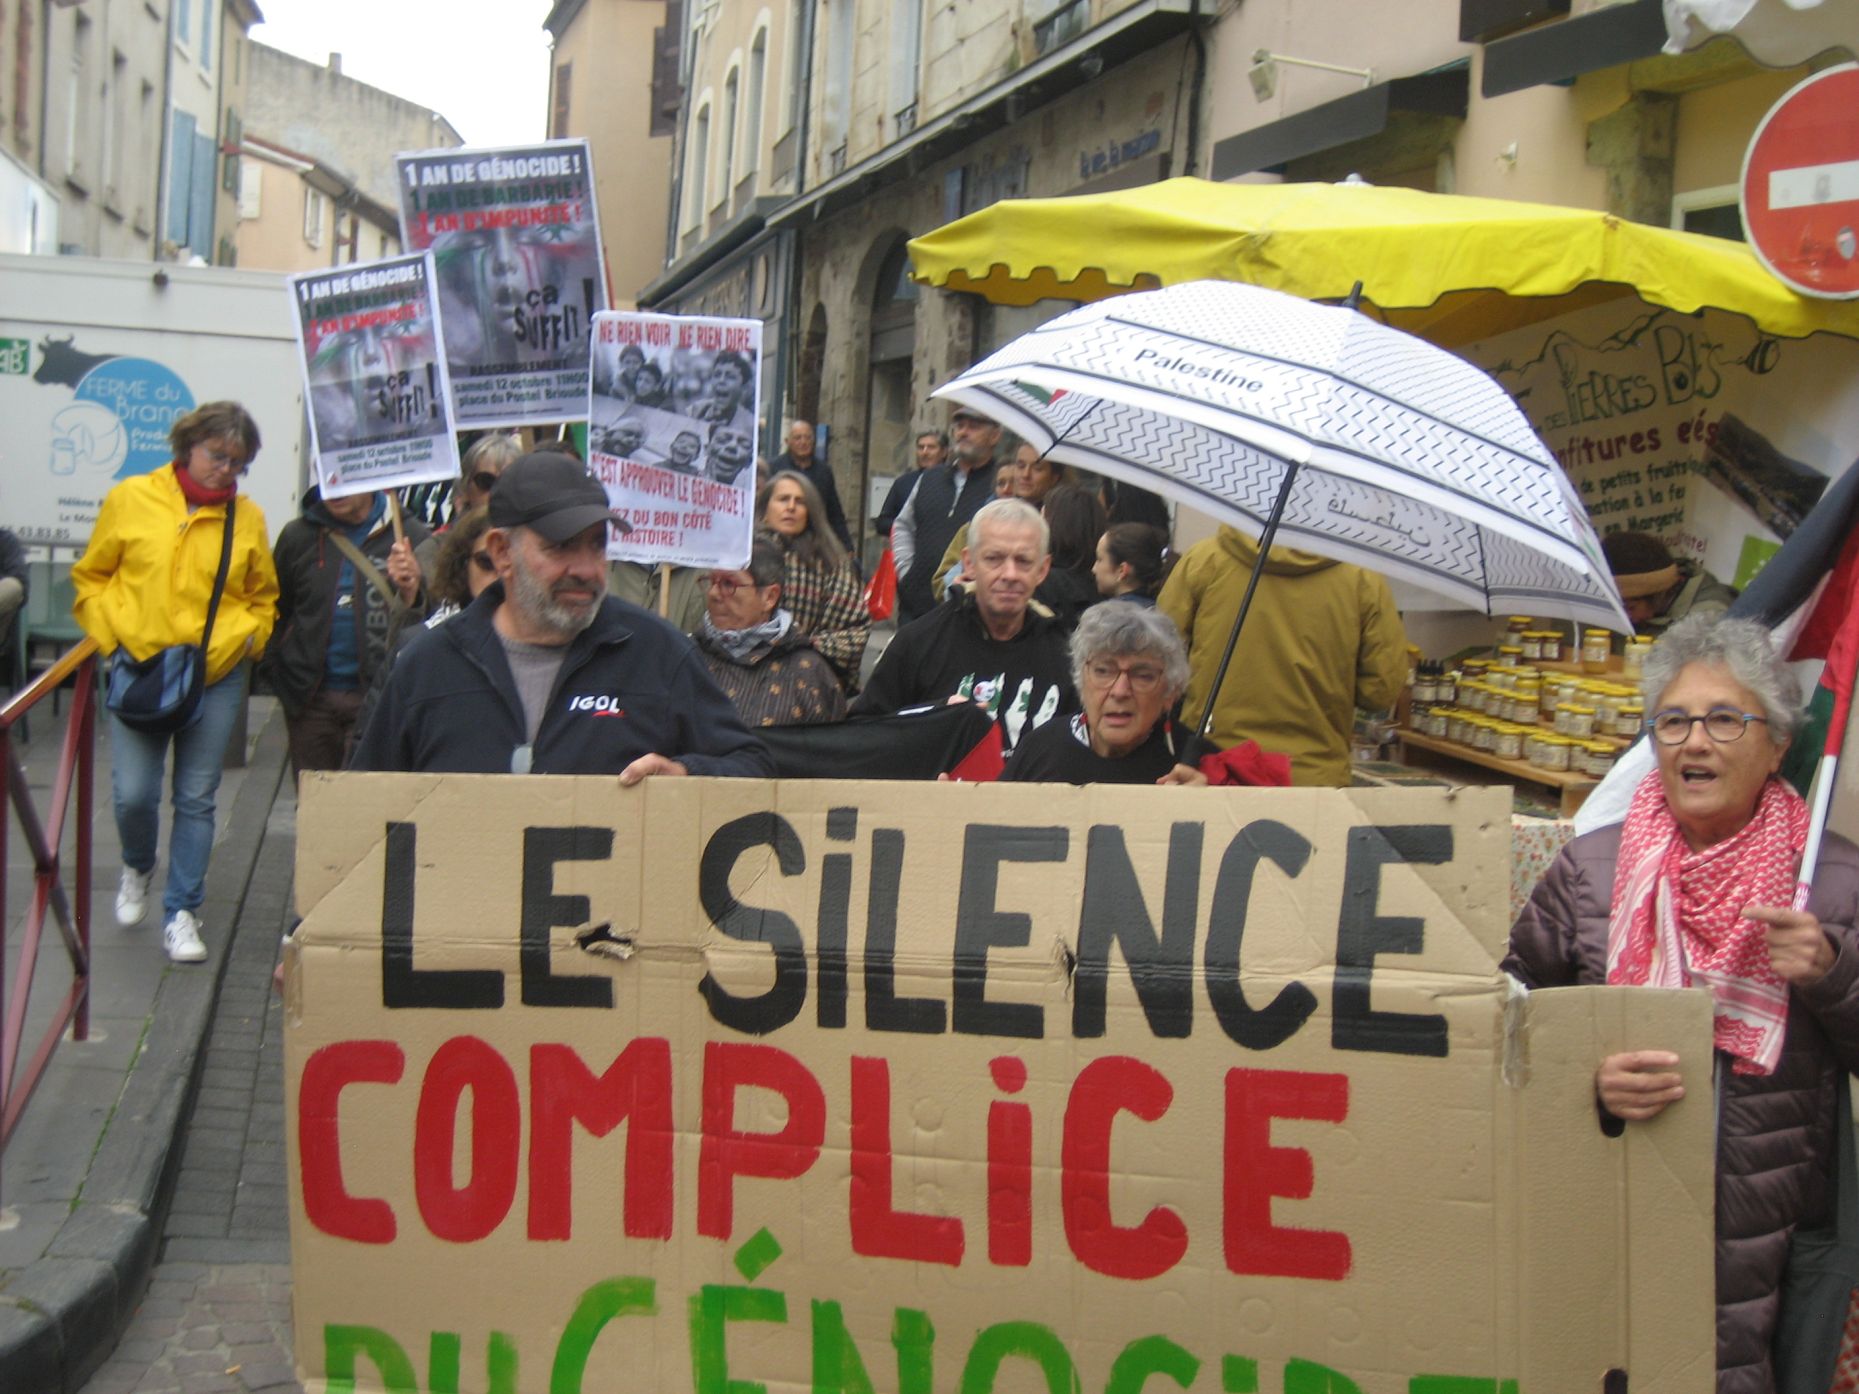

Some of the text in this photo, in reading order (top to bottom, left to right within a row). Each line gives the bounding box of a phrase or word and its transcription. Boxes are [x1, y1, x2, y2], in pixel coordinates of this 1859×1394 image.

[405, 163, 417, 187] 1
[422, 163, 449, 186] AN
[452, 164, 476, 183] DE
[417, 211, 429, 233] 1
[434, 214, 460, 234] AN
[300, 281, 309, 301] 1
[312, 281, 331, 299] AN
[332, 278, 349, 296] DE
[514, 305, 579, 351] SUFFIT
[599, 320, 751, 353] NE RIEN VOIR NE RIEN DIRE
[1134, 348, 1263, 392] Palestine
[84, 378, 181, 401] FERME du
[1557, 427, 1661, 471] nfitures
[620, 461, 675, 499] APPROUVER
[678, 474, 688, 501] LE
[1600, 471, 1640, 495] petits
[633, 509, 650, 526] DU
[654, 511, 678, 527] BON
[682, 509, 712, 530] CÔTÉ
[569, 695, 620, 714] IGOL
[382, 821, 615, 1009] LE
